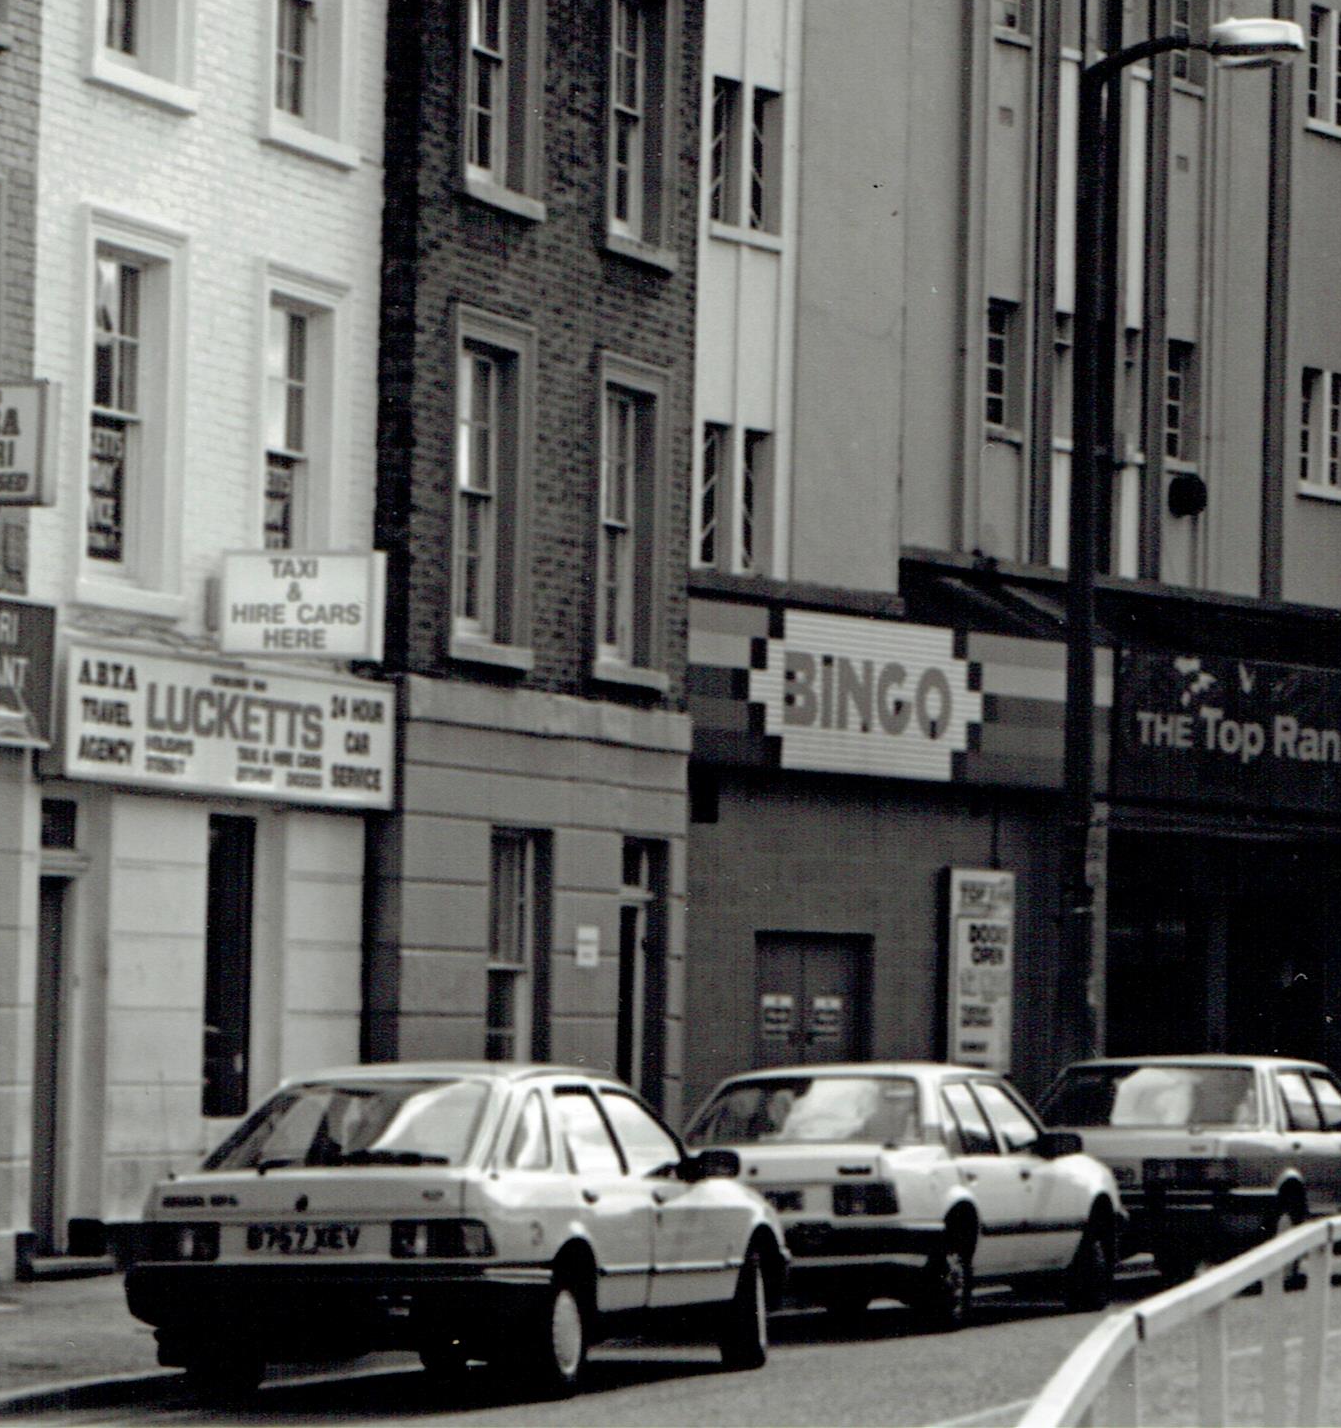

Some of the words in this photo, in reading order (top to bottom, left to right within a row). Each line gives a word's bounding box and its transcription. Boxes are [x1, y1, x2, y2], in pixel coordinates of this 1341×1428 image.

[269, 558, 318, 579] TAXI
[286, 582, 301, 602] &
[231, 604, 285, 624] HIRE
[297, 604, 361, 624] CARS
[264, 629, 327, 650] HERE
[331, 695, 347, 719] 24
[351, 698, 384, 723] HOUR
[784, 651, 952, 740] BINGO
[81, 696, 132, 728] TRAVEL
[146, 682, 324, 750] LUCKETTS
[344, 731, 370, 755] CAR
[1137, 710, 1194, 748] THE
[1199, 706, 1265, 764] Top
[78, 735, 134, 765] AGENCY
[331, 764, 382, 791] SERVICE
